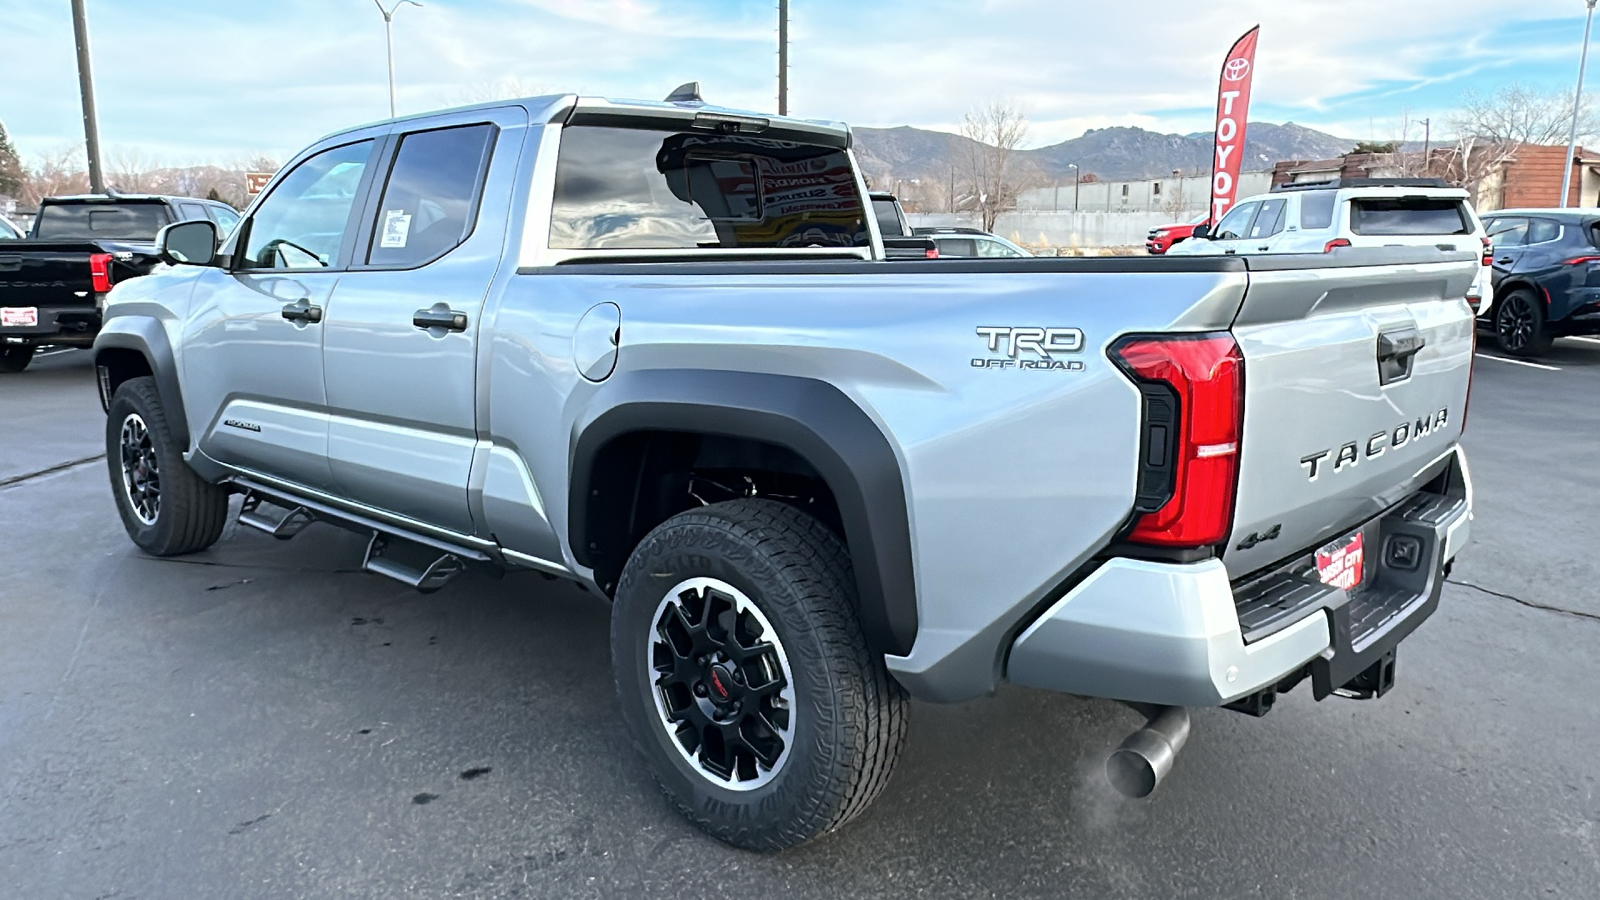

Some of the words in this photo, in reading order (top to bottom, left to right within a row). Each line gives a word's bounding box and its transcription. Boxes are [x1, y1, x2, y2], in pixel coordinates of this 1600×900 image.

[976, 325, 1086, 361] TRD
[970, 358, 1016, 370] OFF
[1019, 359, 1086, 372] ROAD
[1300, 406, 1449, 482] TACOMA
